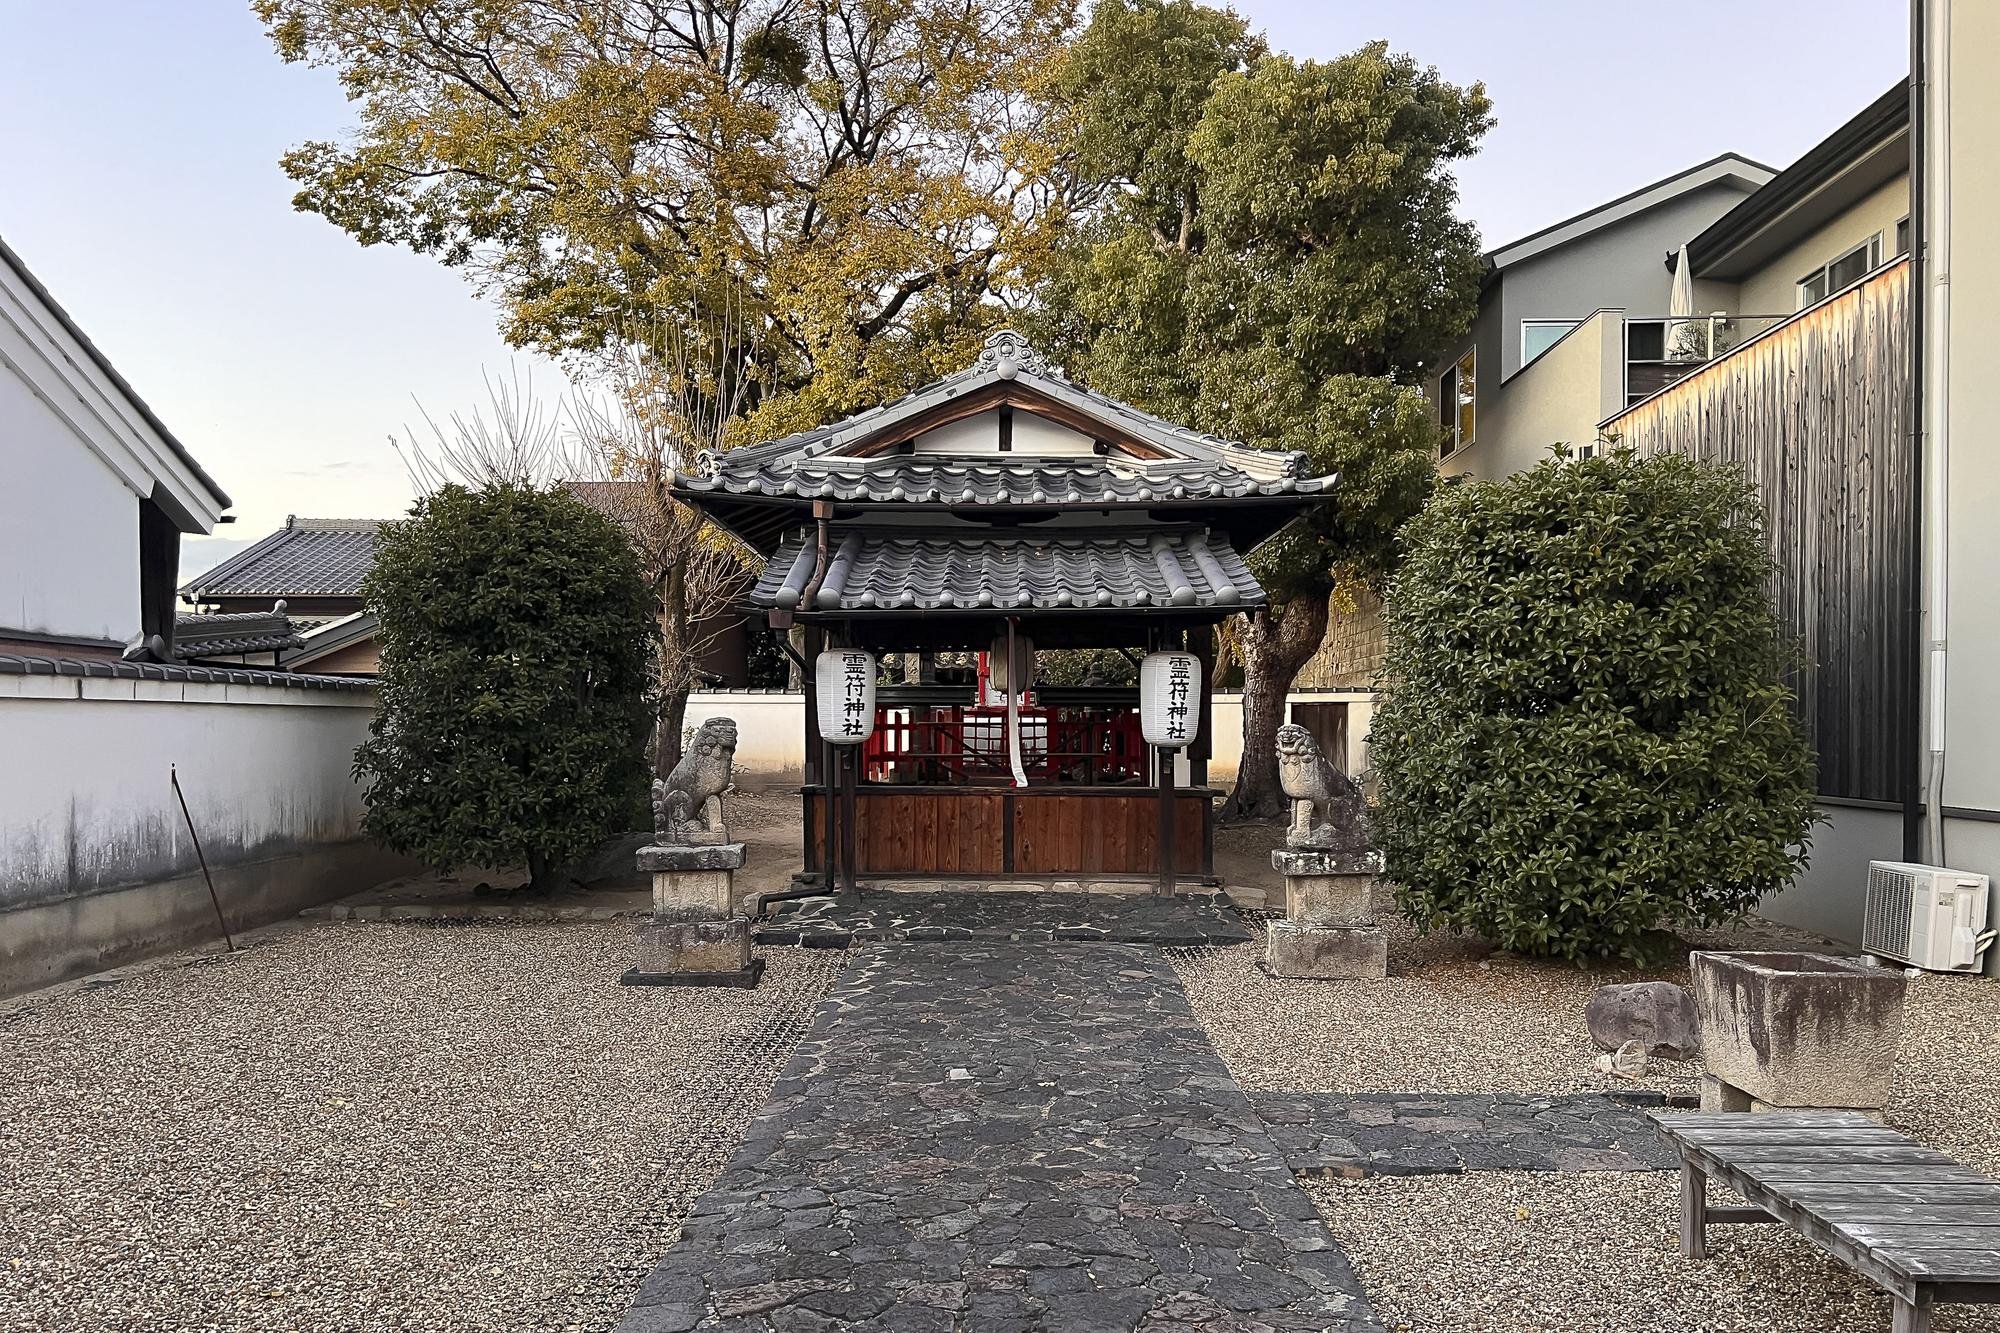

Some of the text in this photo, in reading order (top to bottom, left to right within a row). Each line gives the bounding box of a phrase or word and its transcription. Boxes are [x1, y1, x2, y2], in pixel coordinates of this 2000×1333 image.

[842, 652, 867, 736] 霊符神社
[1166, 657, 1192, 739] 霊符神社
